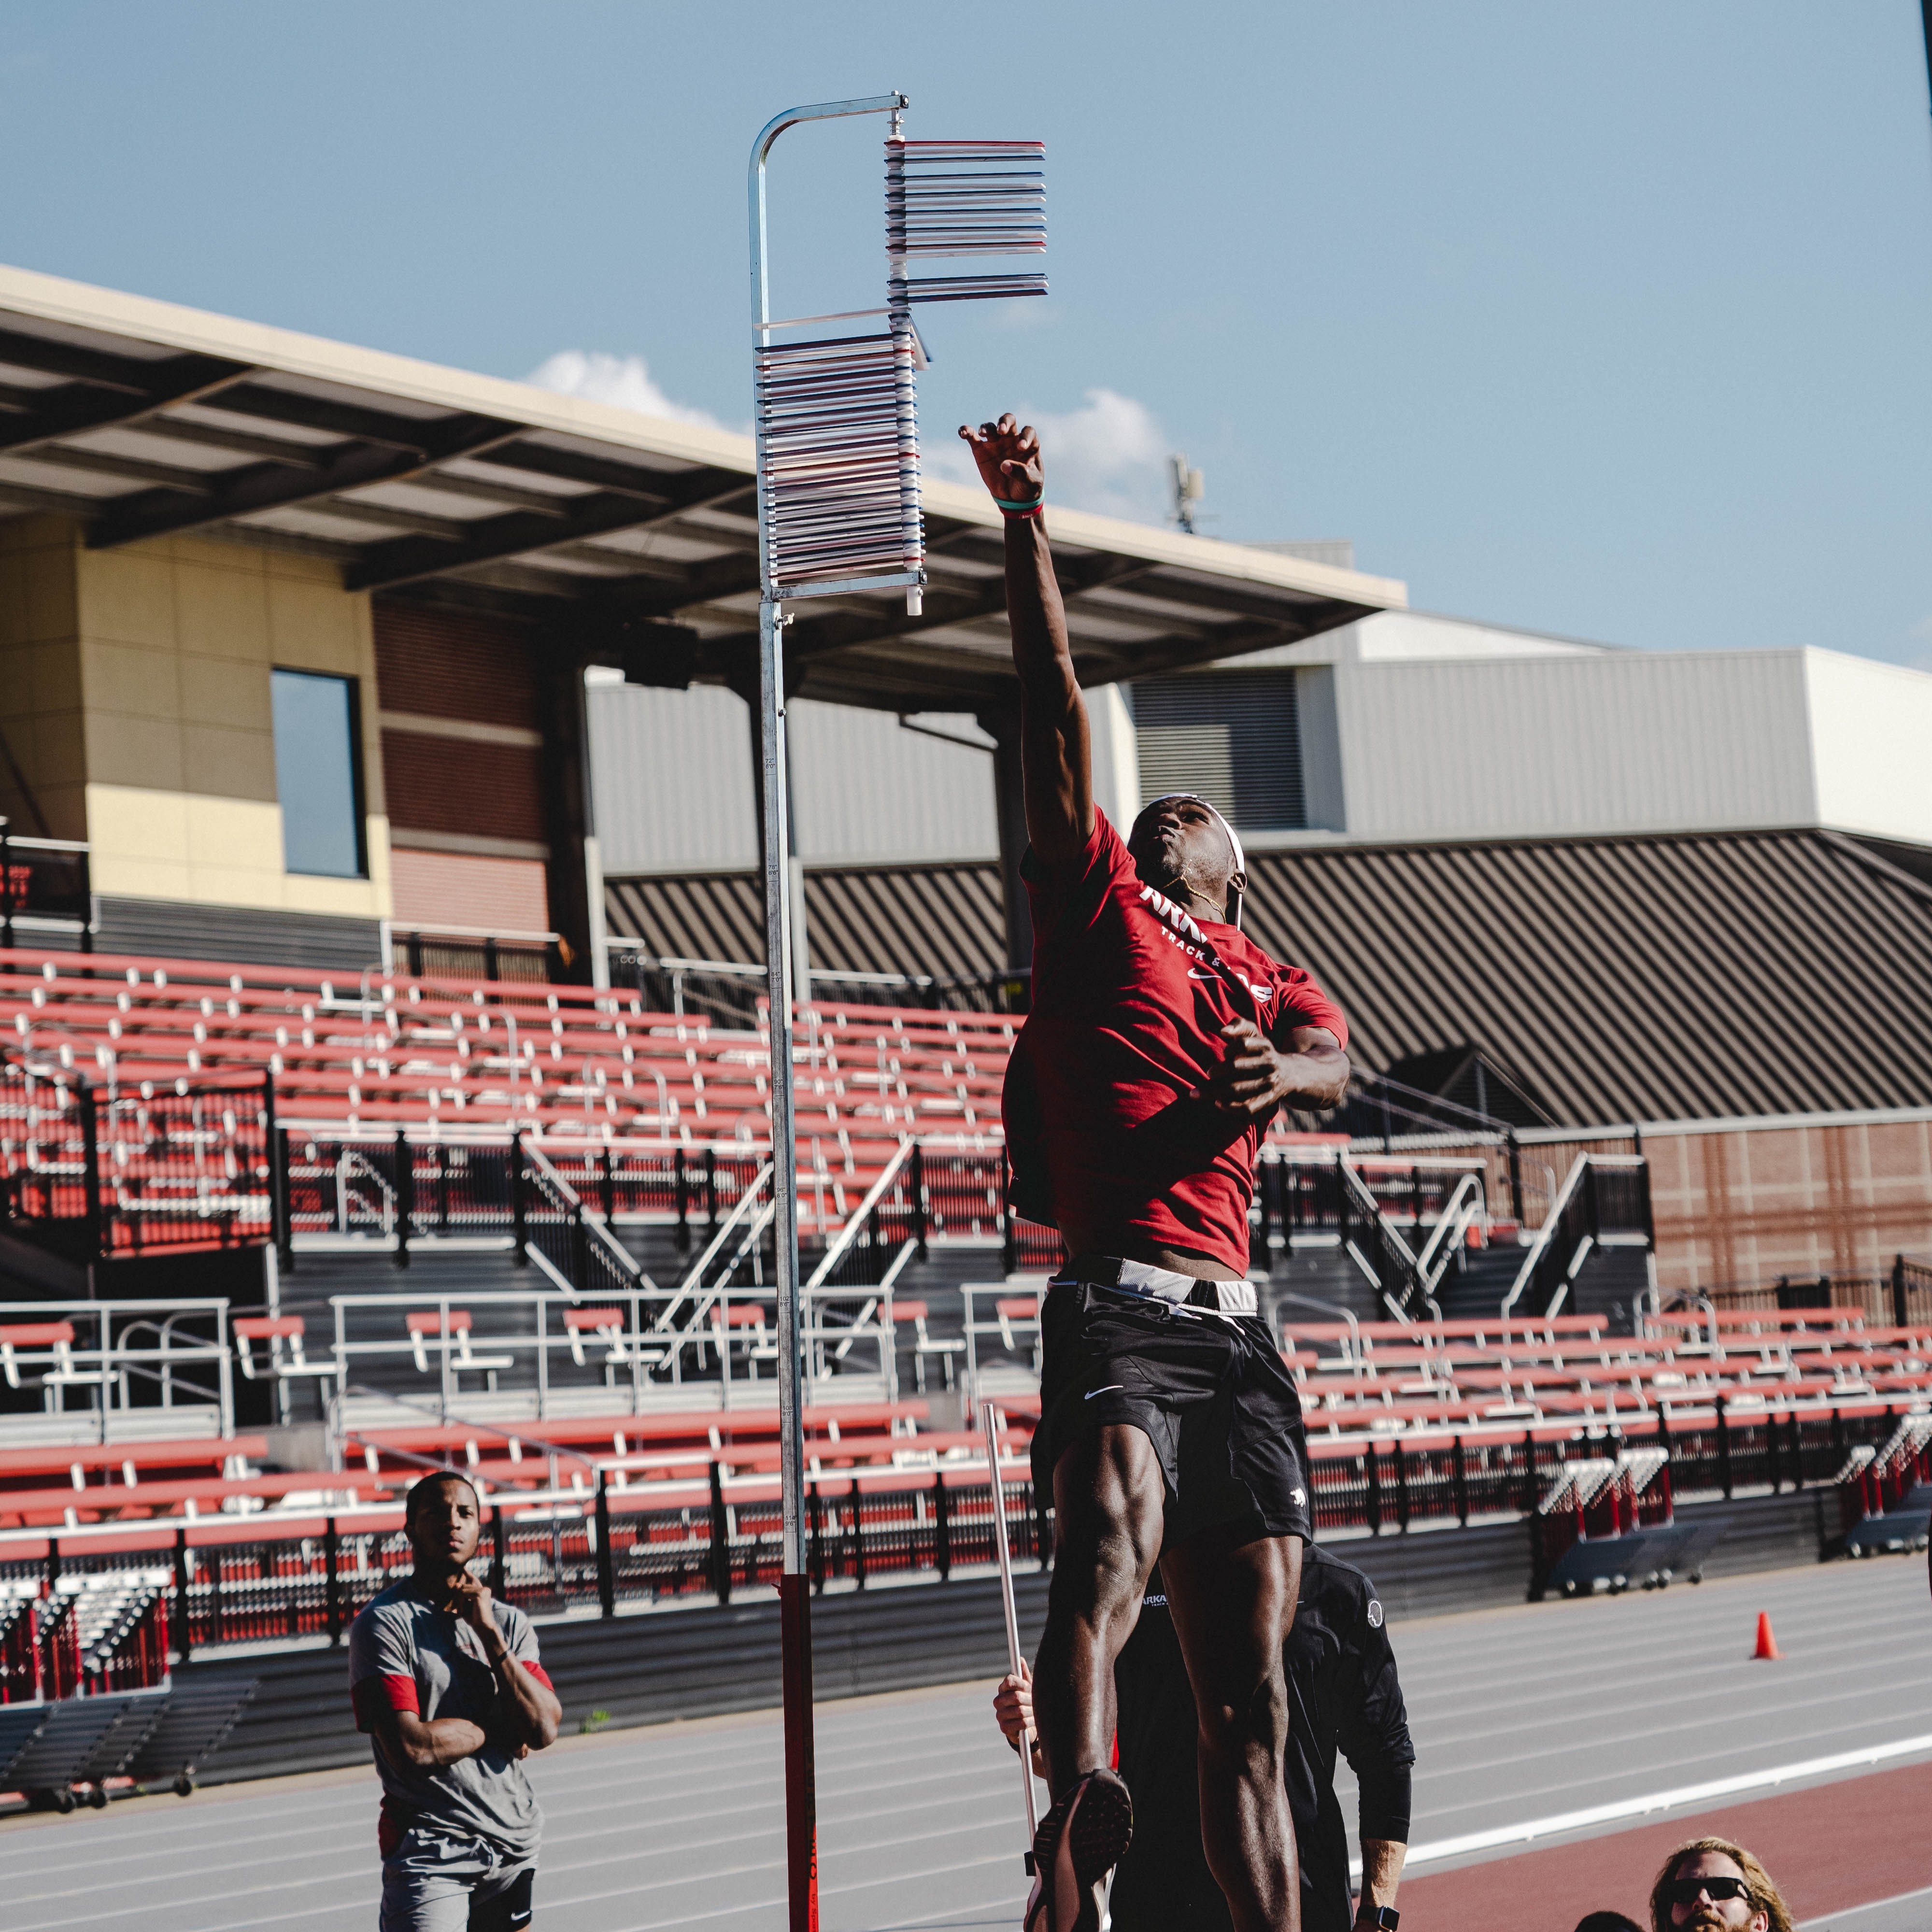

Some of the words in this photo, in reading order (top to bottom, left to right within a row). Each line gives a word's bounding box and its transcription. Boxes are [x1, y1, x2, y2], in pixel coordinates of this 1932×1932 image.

[1162, 926, 1205, 961] TRACK
[1212, 957, 1220, 966] &
[811, 1894, 817, 1904] by
